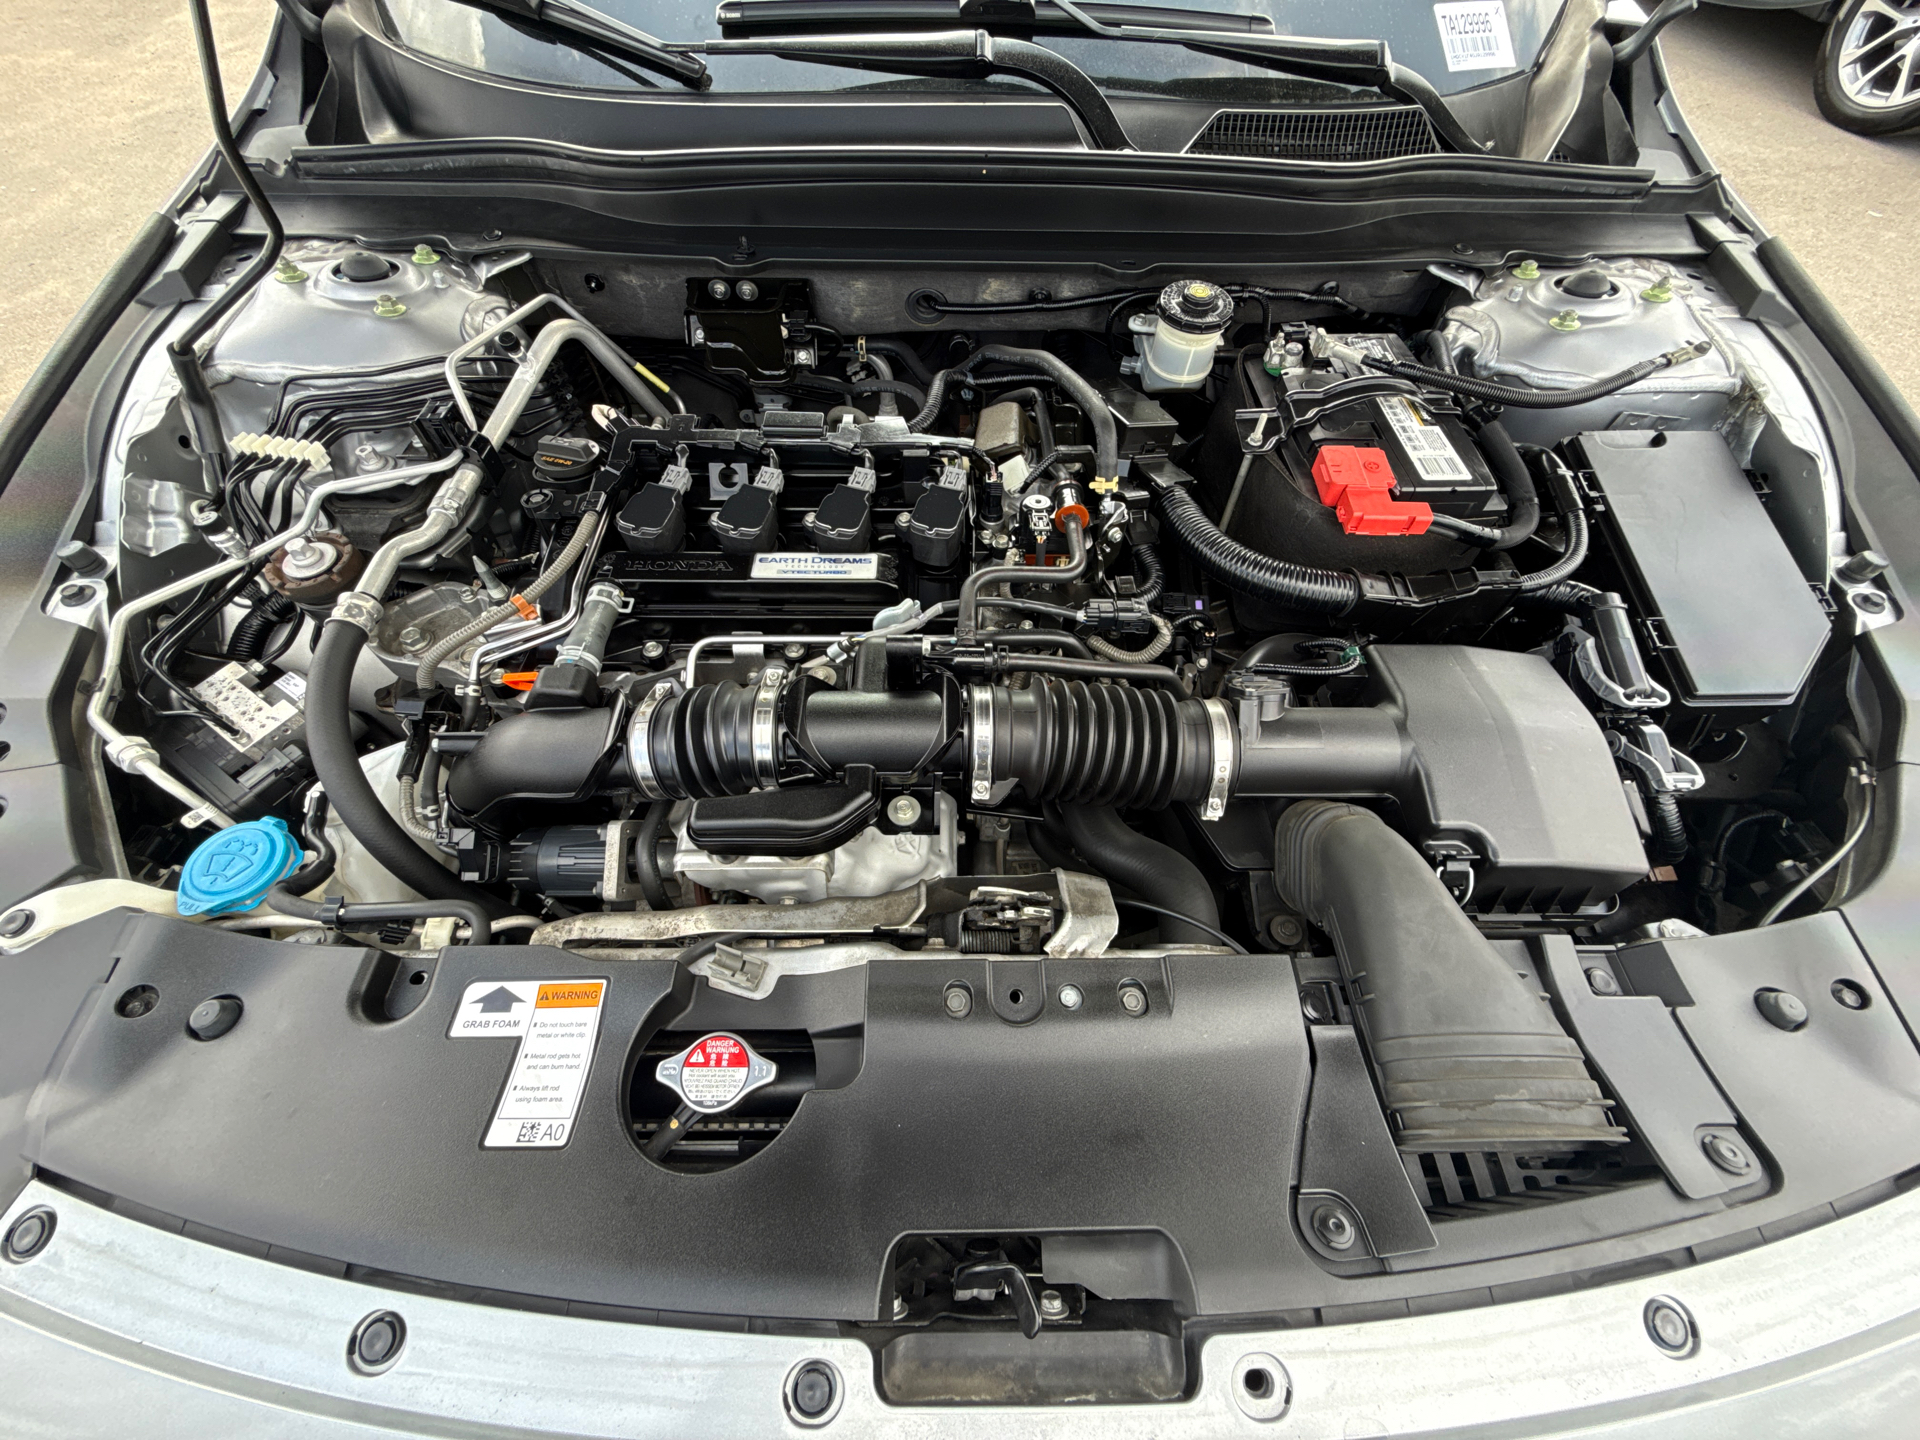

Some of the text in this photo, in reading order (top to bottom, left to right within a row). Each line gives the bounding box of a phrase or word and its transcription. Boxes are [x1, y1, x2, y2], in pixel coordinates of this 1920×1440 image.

[1441, 12, 1492, 36] TA129996
[626, 560, 733, 572] HONDA
[811, 556, 872, 564] DREAMS
[179, 901, 201, 913] PULL
[551, 990, 598, 1000] WARNING
[463, 1020, 521, 1028] GRAB FOAM
[540, 1123, 565, 1141] A0
